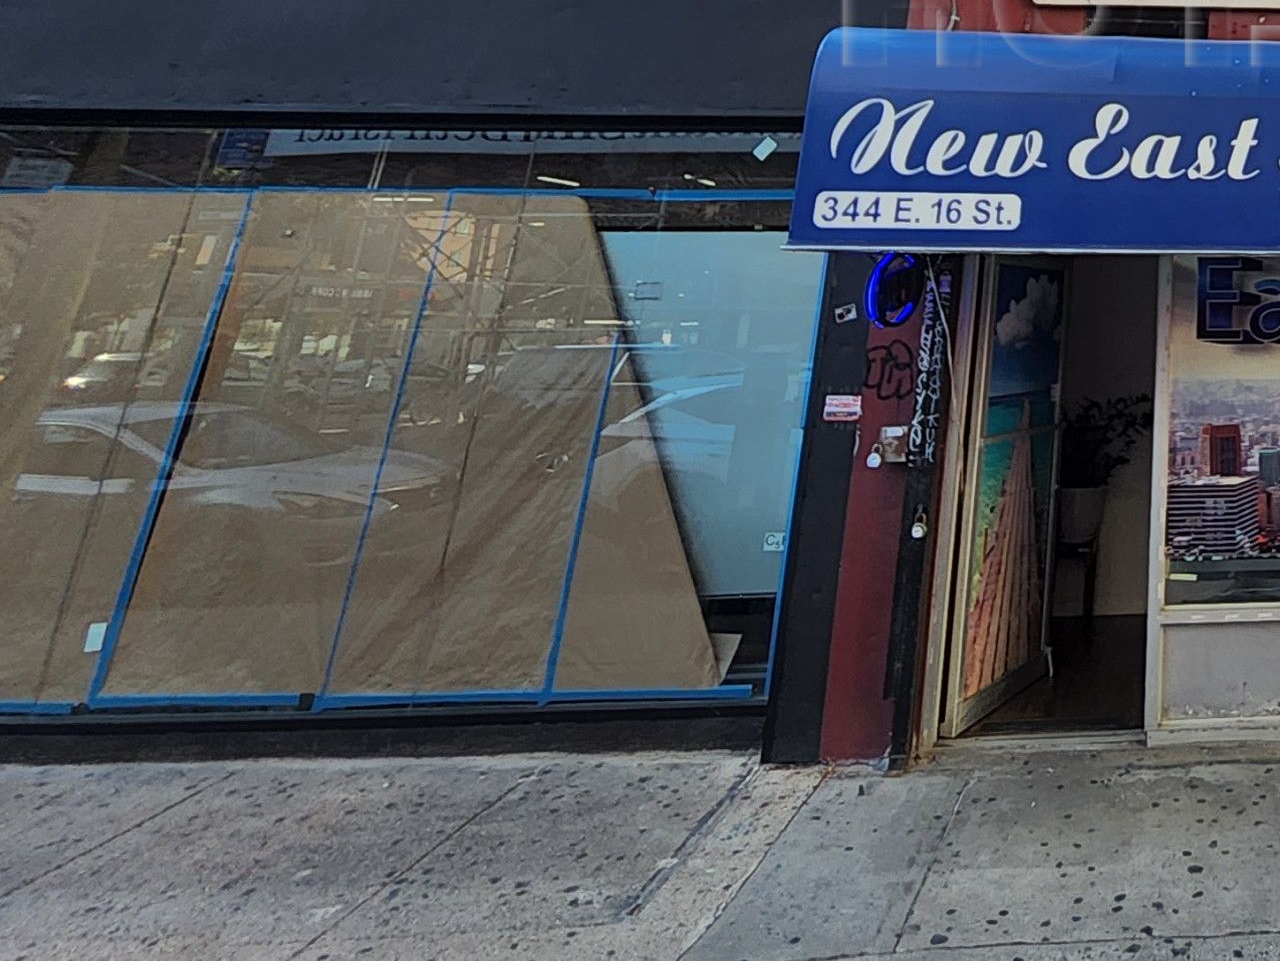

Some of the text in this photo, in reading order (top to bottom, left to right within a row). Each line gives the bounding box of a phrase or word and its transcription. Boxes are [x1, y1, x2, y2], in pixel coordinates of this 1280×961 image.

[830, 97, 1048, 176] New
[1068, 102, 1262, 181] East
[821, 197, 1012, 226] 344 E. 16 St.
